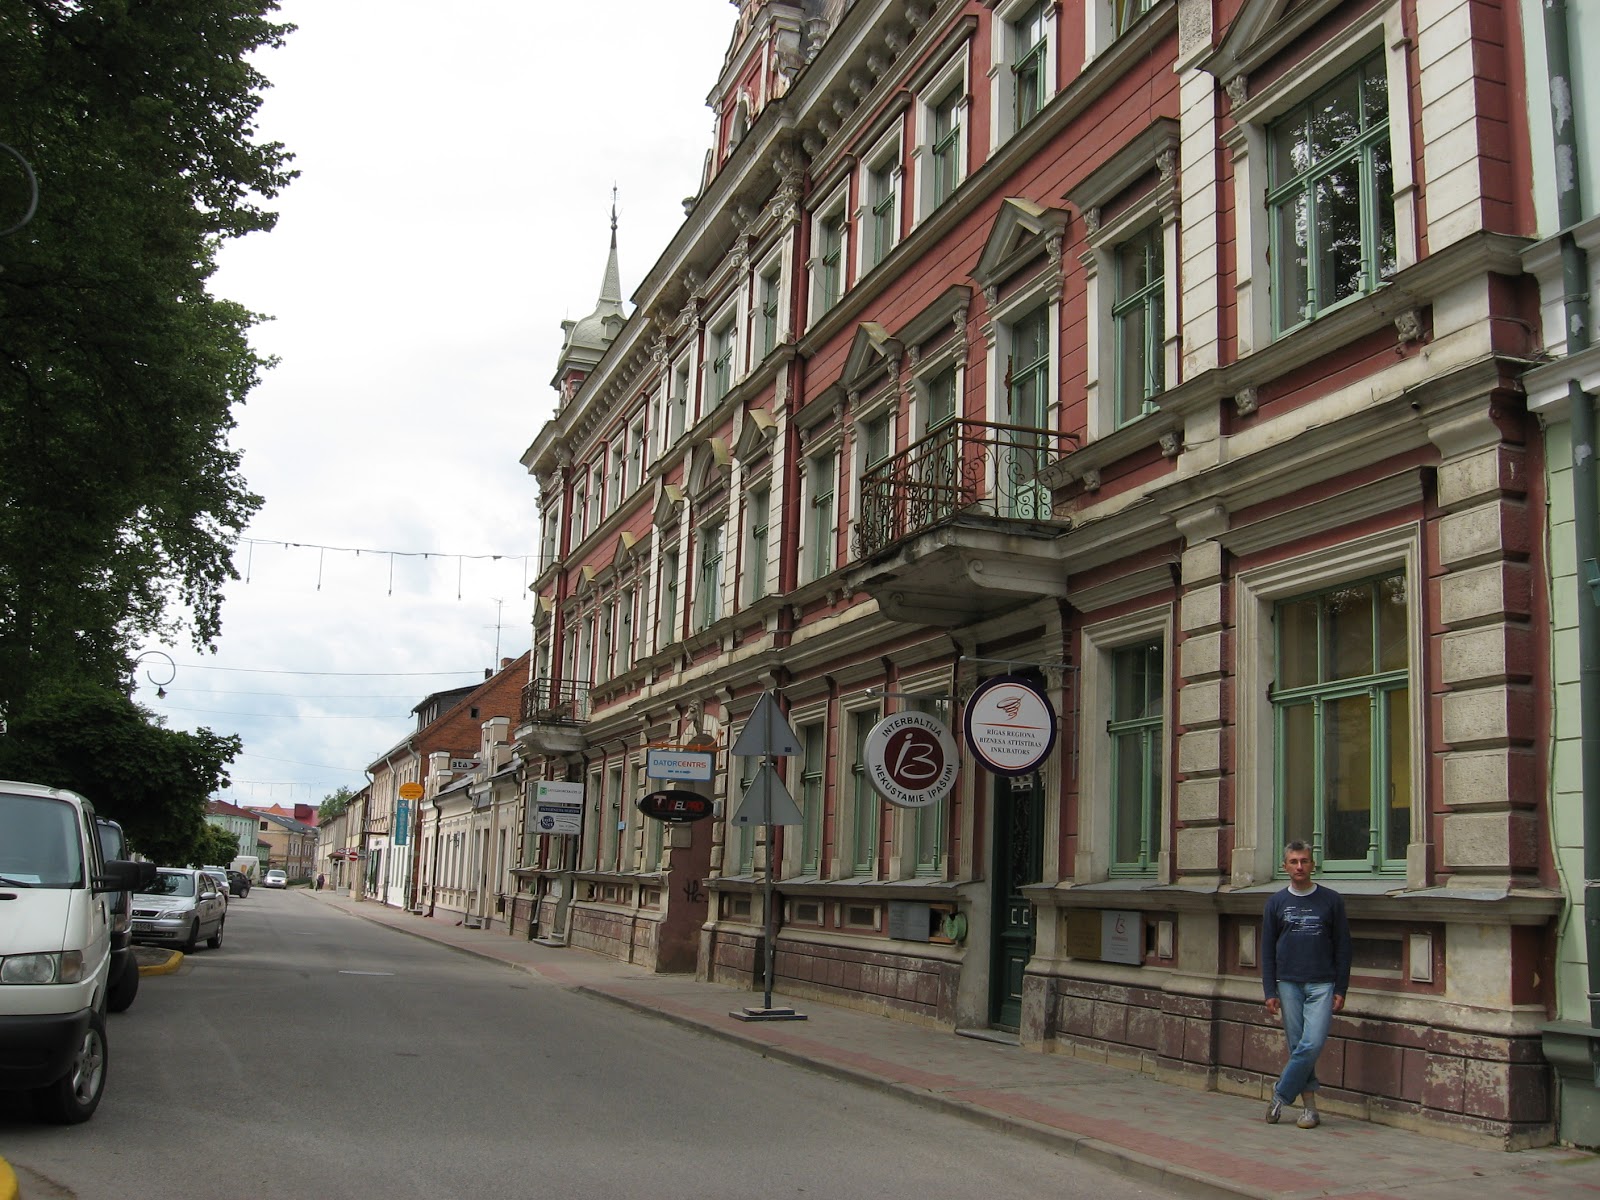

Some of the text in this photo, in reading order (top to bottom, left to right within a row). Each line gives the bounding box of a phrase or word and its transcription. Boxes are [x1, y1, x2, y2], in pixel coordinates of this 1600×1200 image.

[882, 716, 942, 738] INTERBALTIJA
[990, 746, 1030, 755] INKUBATORS
[653, 759, 707, 769] DATORCENTRS
[874, 763, 926, 803] NEKUSTAMIE
